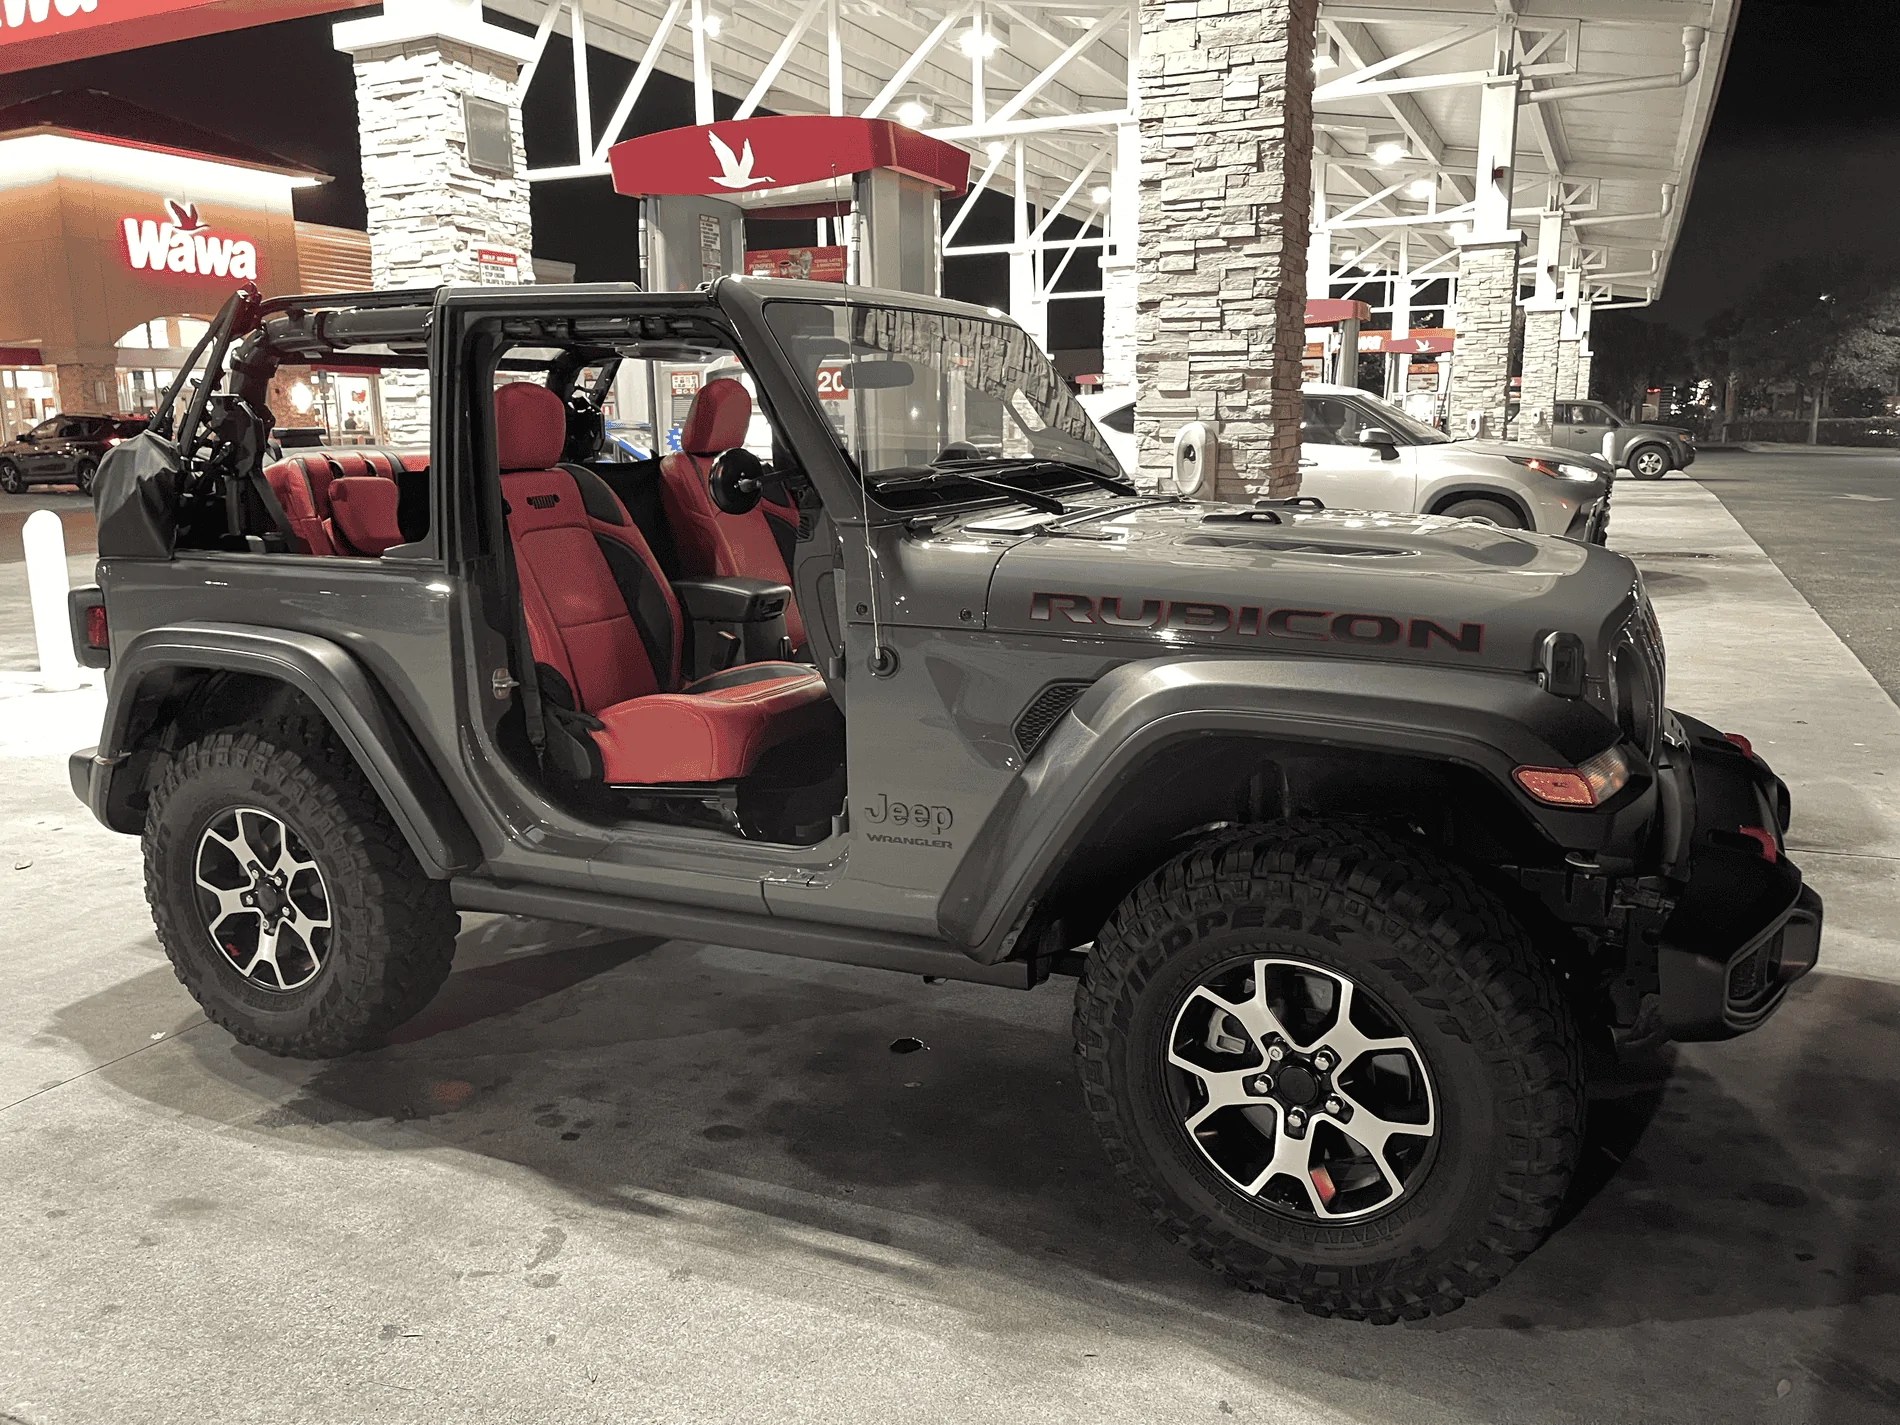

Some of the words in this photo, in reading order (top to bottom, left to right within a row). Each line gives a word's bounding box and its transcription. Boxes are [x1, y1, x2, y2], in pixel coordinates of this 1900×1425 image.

[123, 217, 257, 280] Wawa
[1029, 591, 1486, 654] RUBICON
[864, 793, 953, 835] Jeep
[866, 833, 953, 849] WRANGLER
[1112, 906, 1355, 1034] WILDPEAK
